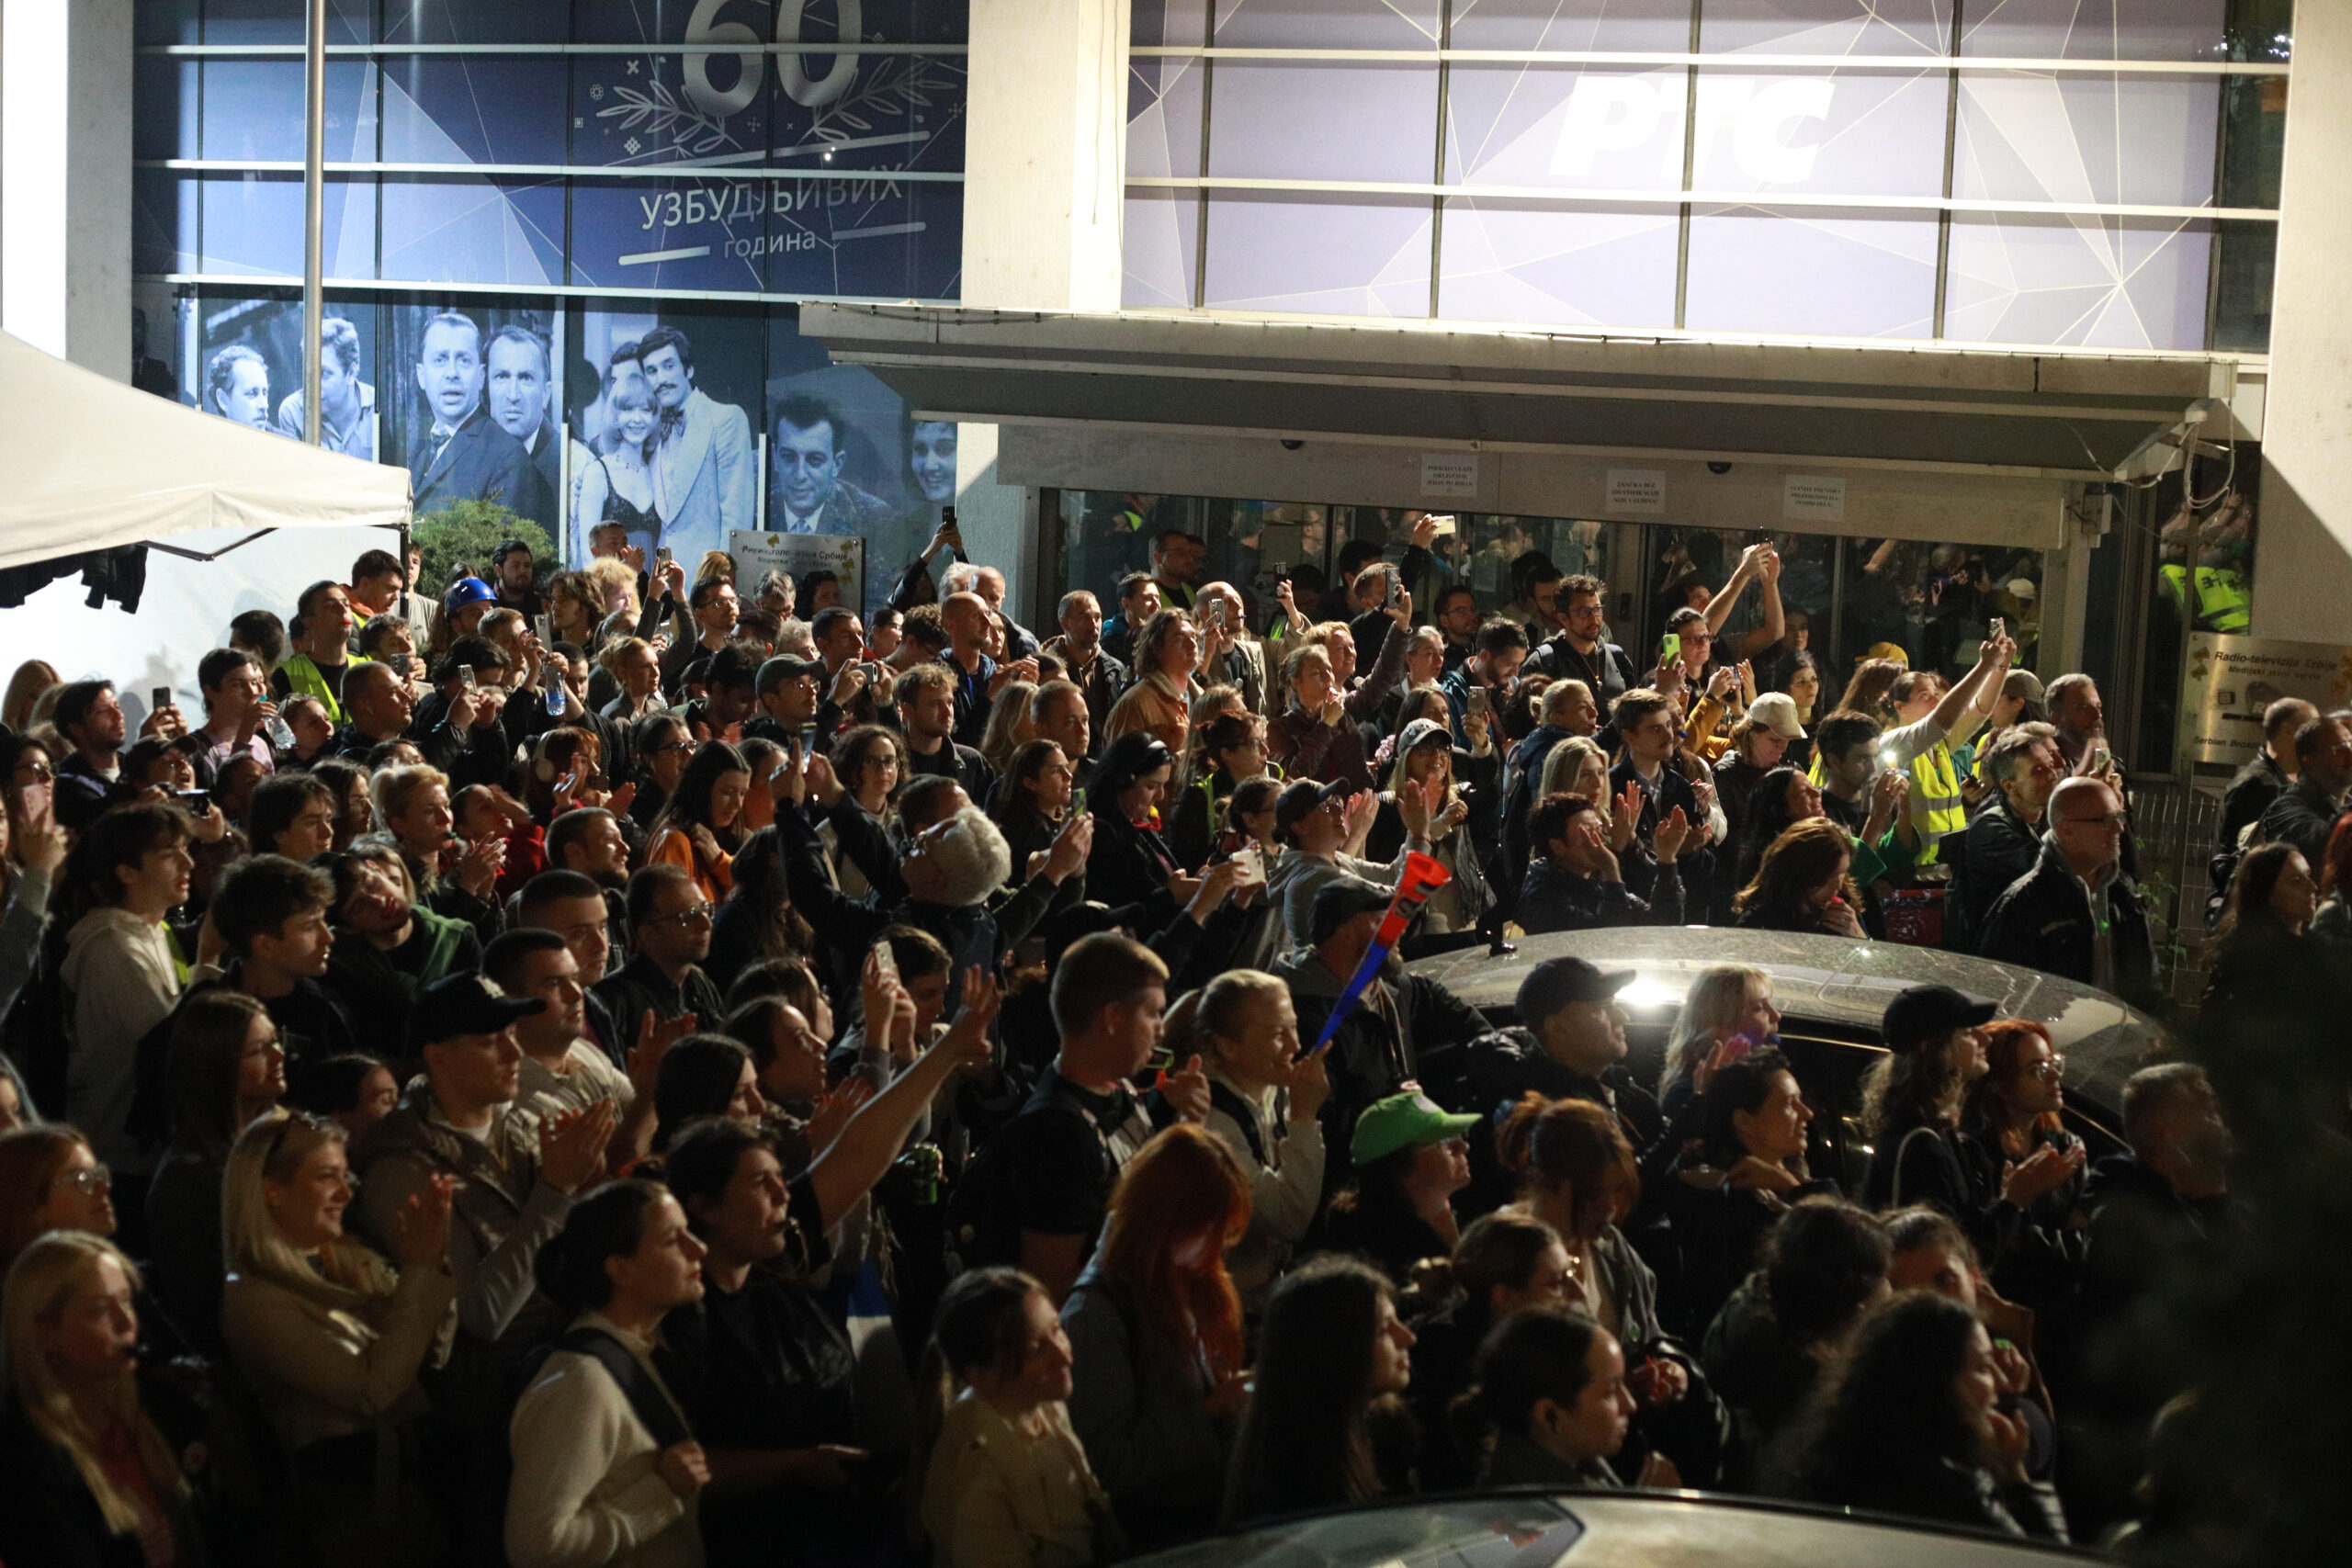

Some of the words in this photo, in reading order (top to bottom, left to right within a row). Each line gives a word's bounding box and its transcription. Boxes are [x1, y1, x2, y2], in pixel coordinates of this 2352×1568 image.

[682, 0, 862, 117] 60
[1548, 75, 1836, 185] РТС
[724, 230, 817, 259] година
[2214, 650, 2300, 669] Radio-televizija
[2192, 736, 2226, 747] Serbian
